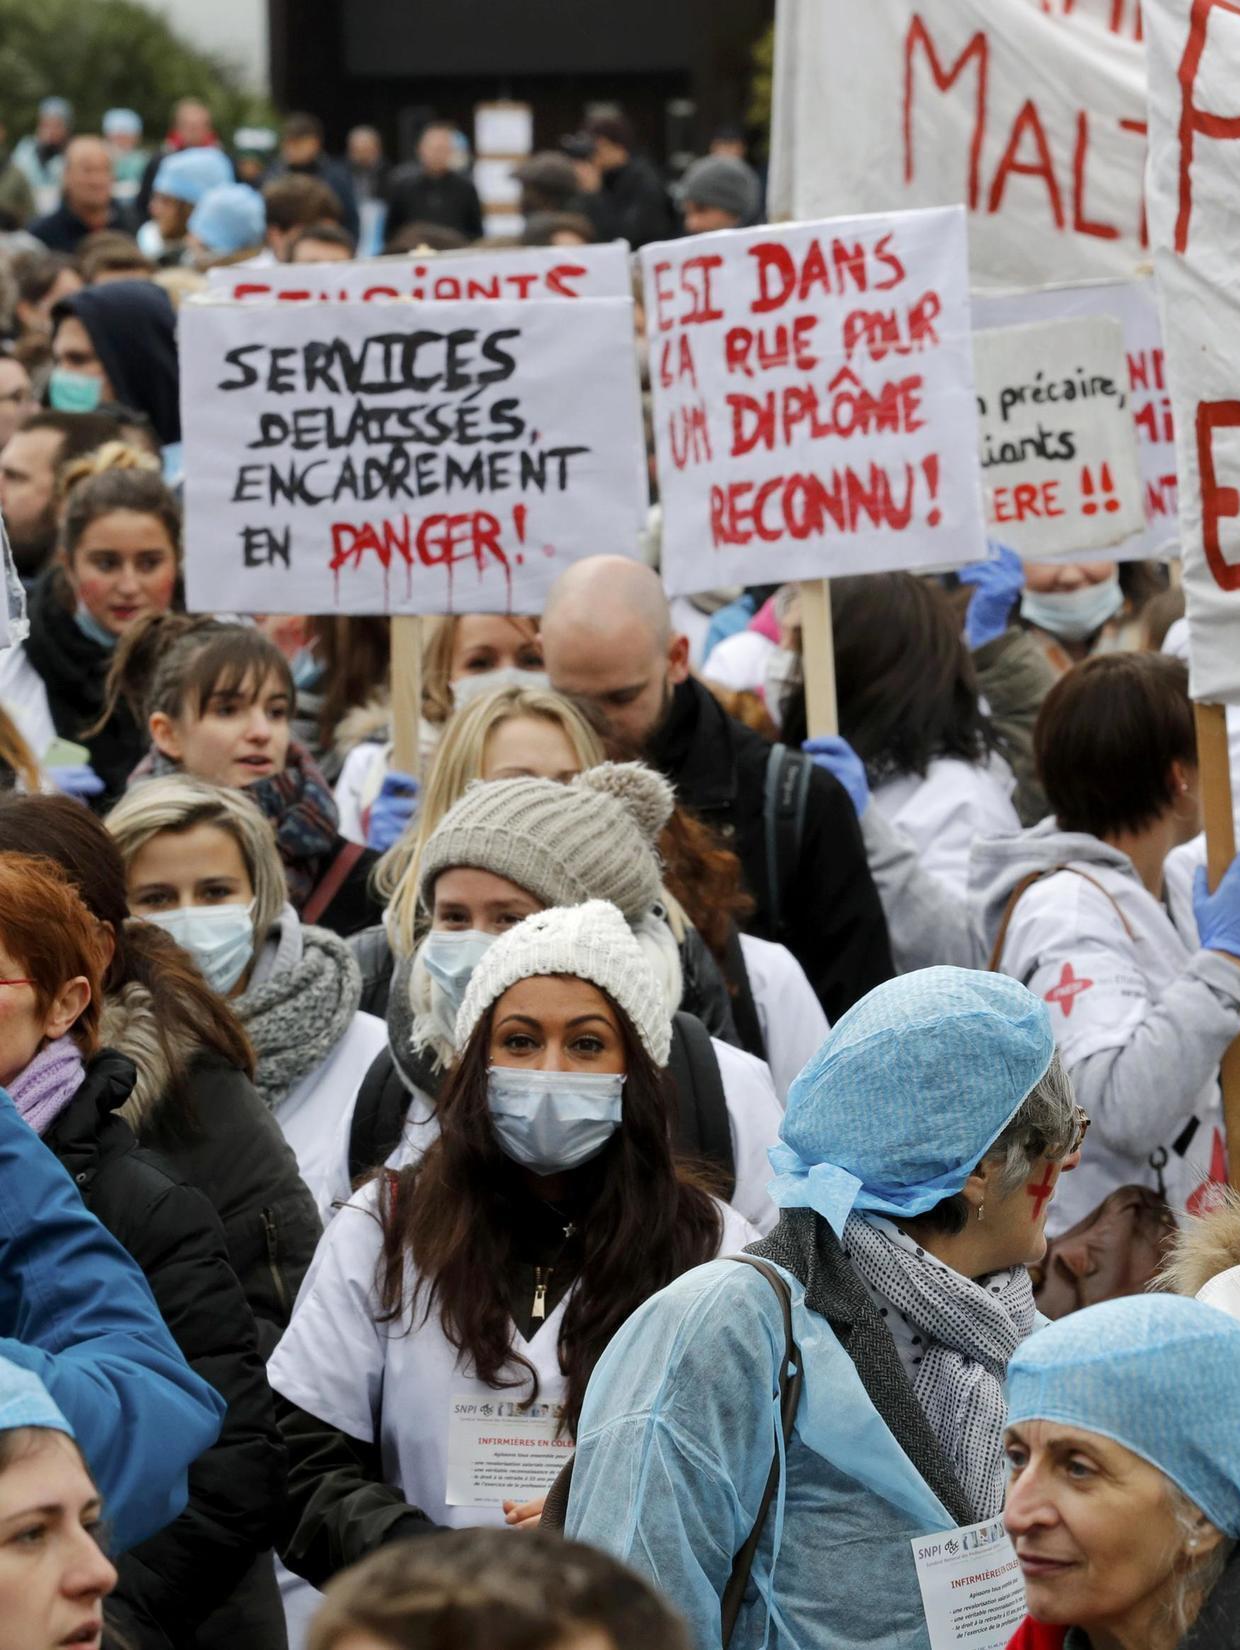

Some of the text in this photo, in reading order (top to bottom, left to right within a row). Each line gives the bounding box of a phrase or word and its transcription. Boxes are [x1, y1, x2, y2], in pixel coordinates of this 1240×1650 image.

[747, 231, 907, 314] DANS
[218, 328, 521, 394] SERVICES
[660, 291, 943, 389] LA RUE POUR
[668, 365, 927, 470] UN DIPLÔME
[1000, 368, 1126, 421] précaire,
[231, 445, 591, 506] ENCADREMENT
[710, 453, 943, 548] RECONNU!
[240, 503, 528, 574] EN DANGER!
[453, 1404, 477, 1415] SNPI
[537, 1439, 549, 1447] EN
[918, 1544, 942, 1560] SNPI
